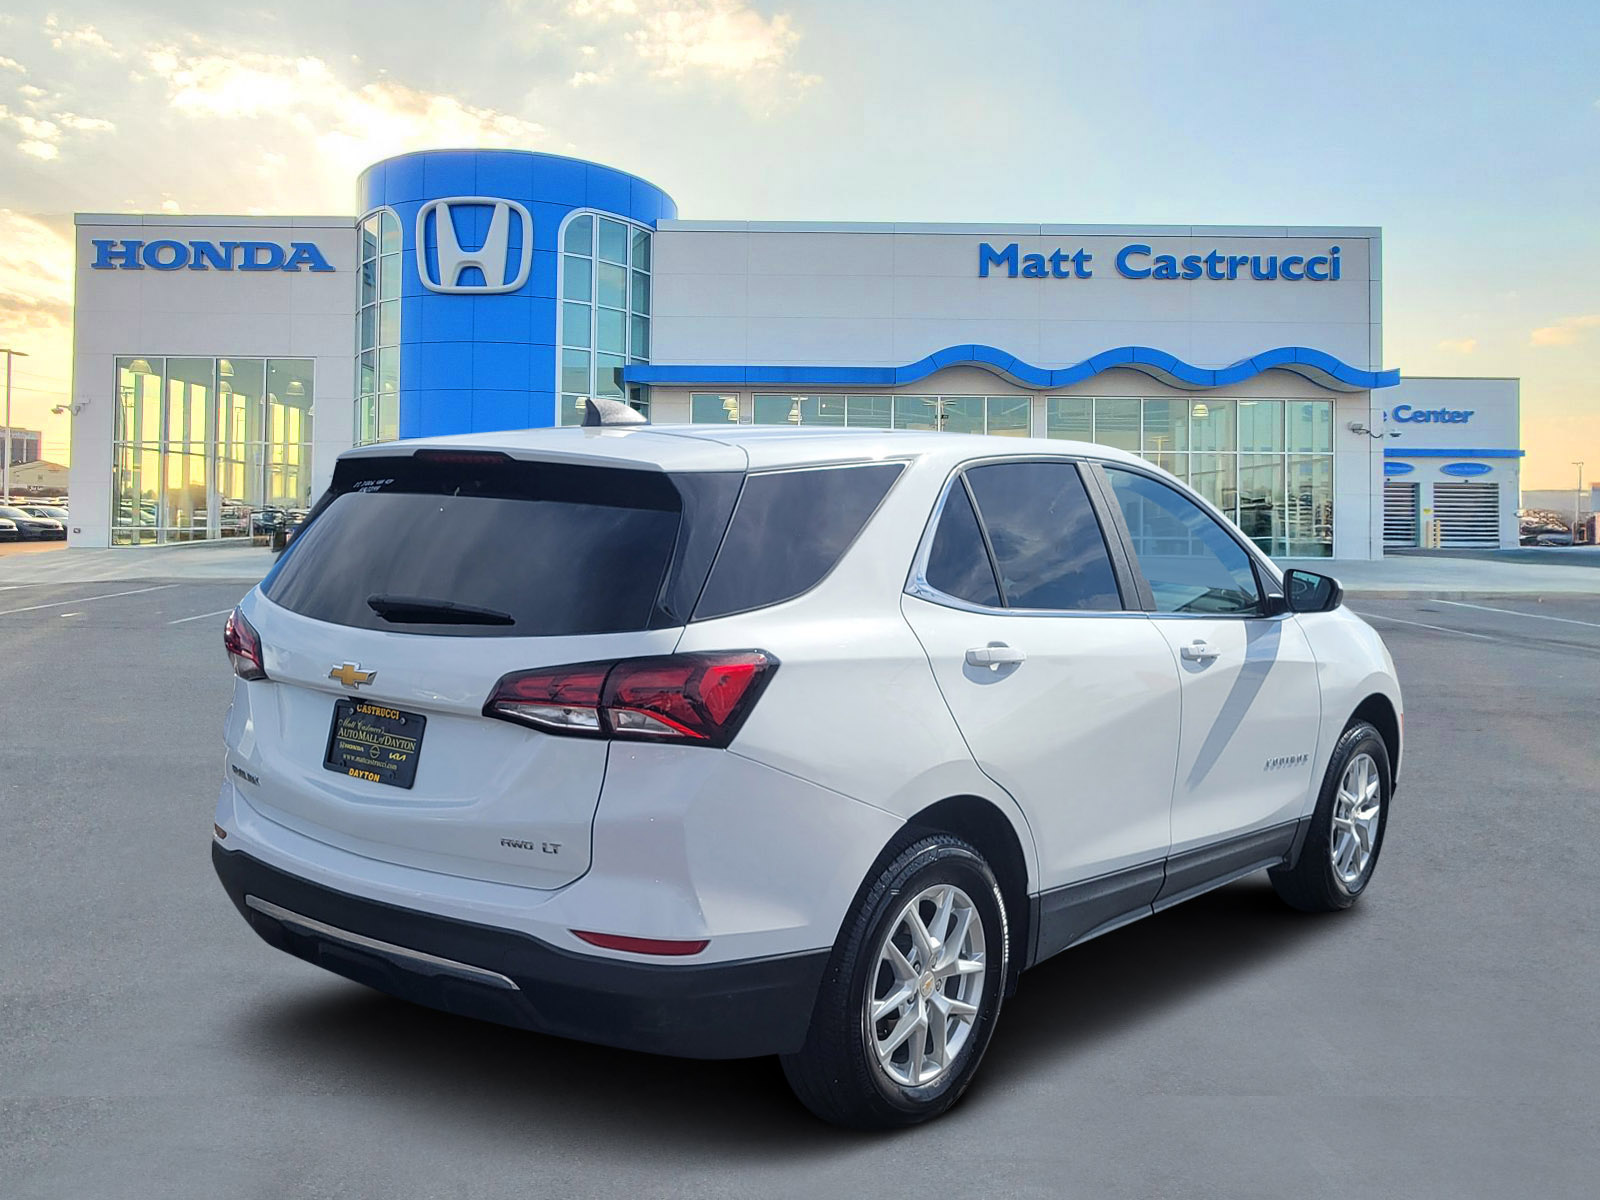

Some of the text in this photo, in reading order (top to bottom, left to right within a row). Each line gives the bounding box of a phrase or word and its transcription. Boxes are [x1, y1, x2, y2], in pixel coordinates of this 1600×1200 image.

[91, 239, 336, 272] HONDA
[978, 242, 1342, 281] Matt Castrucci
[1392, 404, 1475, 424] Center
[356, 704, 400, 720] CASTRUCCI
[349, 768, 380, 783] DAYTON
[541, 842, 562, 855] LT
